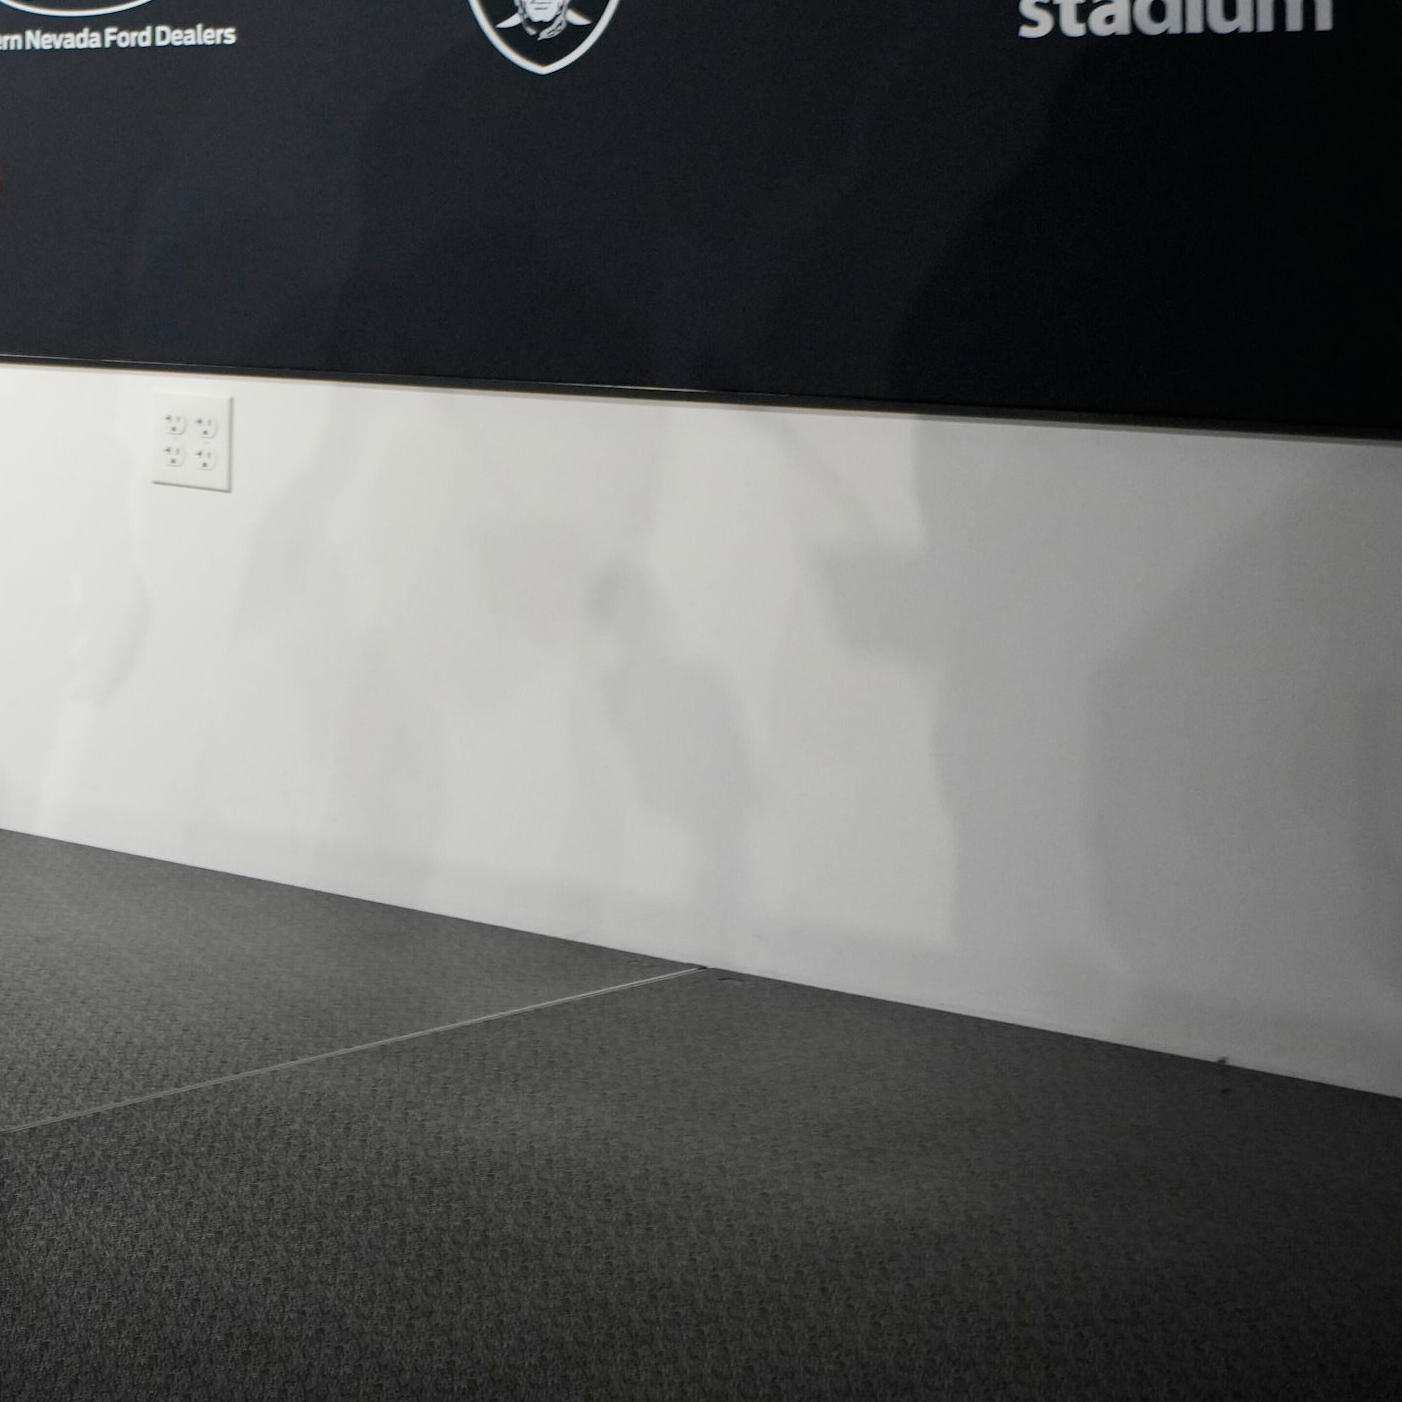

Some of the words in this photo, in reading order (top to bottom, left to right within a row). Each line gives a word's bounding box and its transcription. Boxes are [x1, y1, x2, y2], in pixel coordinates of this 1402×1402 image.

[24, 26, 101, 50] Nevada
[103, 24, 152, 49] Ford
[154, 22, 237, 47] Dealers
